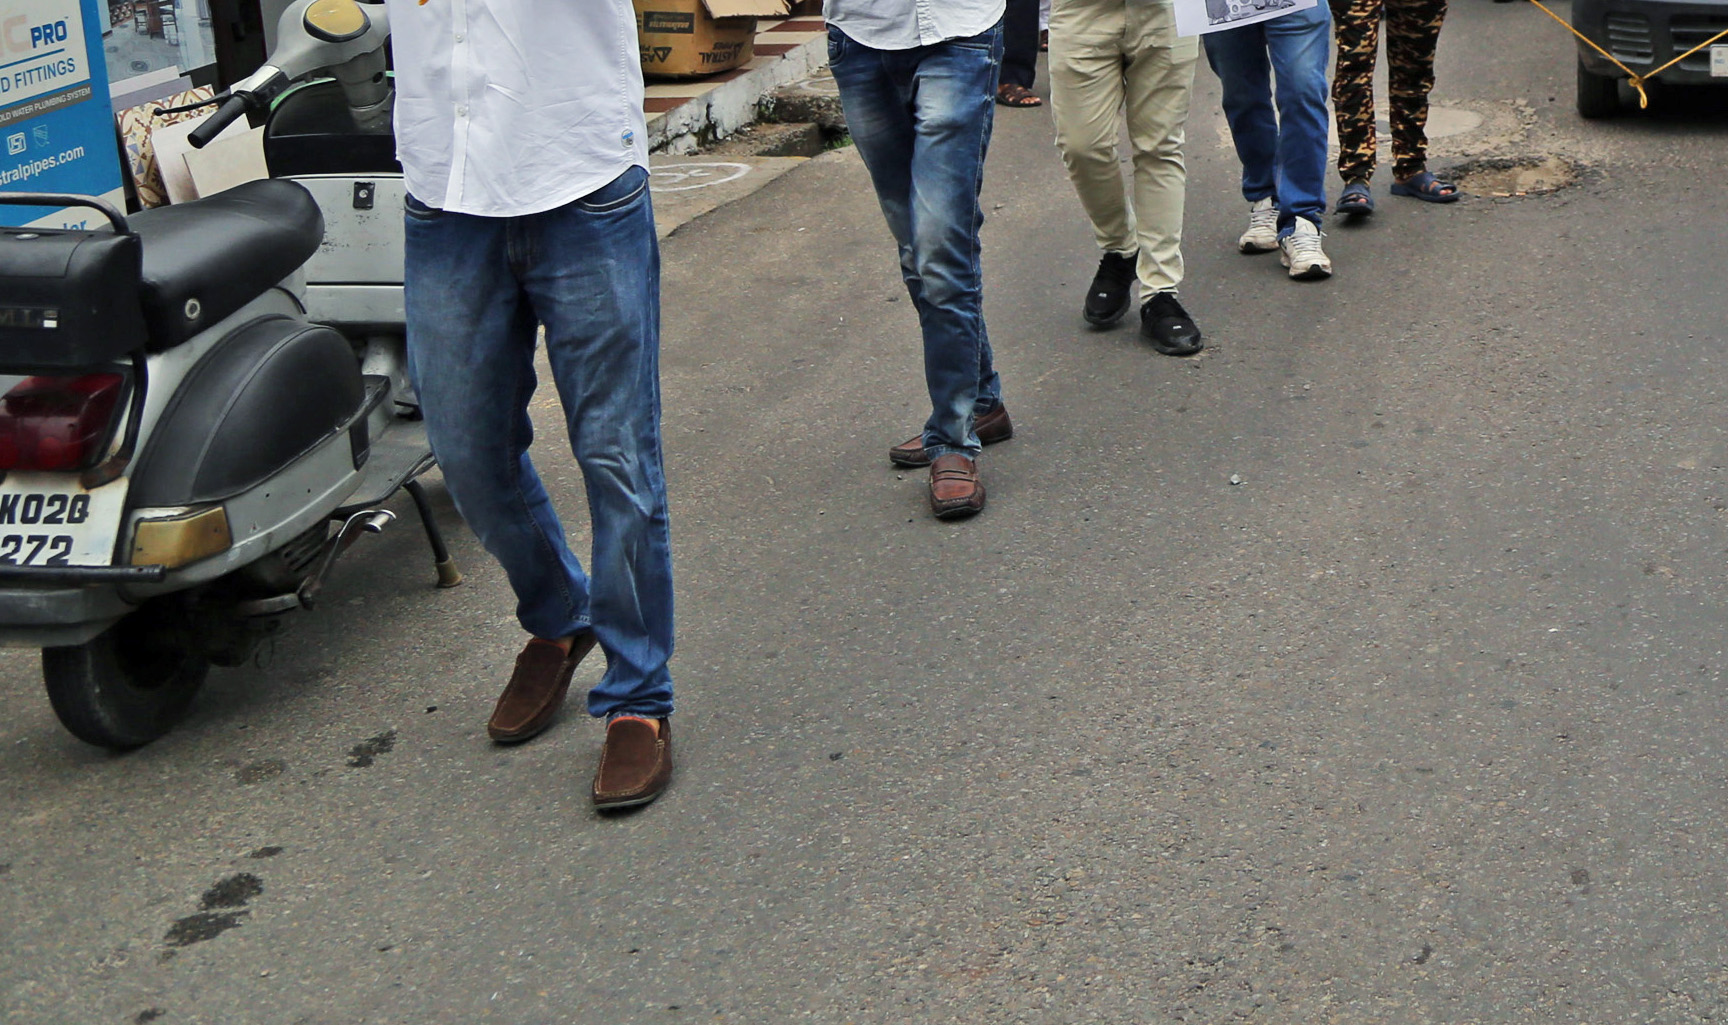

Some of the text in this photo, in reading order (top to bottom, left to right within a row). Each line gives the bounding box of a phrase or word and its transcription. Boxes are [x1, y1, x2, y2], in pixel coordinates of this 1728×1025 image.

[30, 19, 67, 48] PRO
[14, 57, 76, 89] FITTINGS
[11, 104, 34, 119] WATER
[34, 95, 66, 112] PLUMBING
[66, 87, 91, 102] SYSTEM
[0, 493, 91, 525] K02Q
